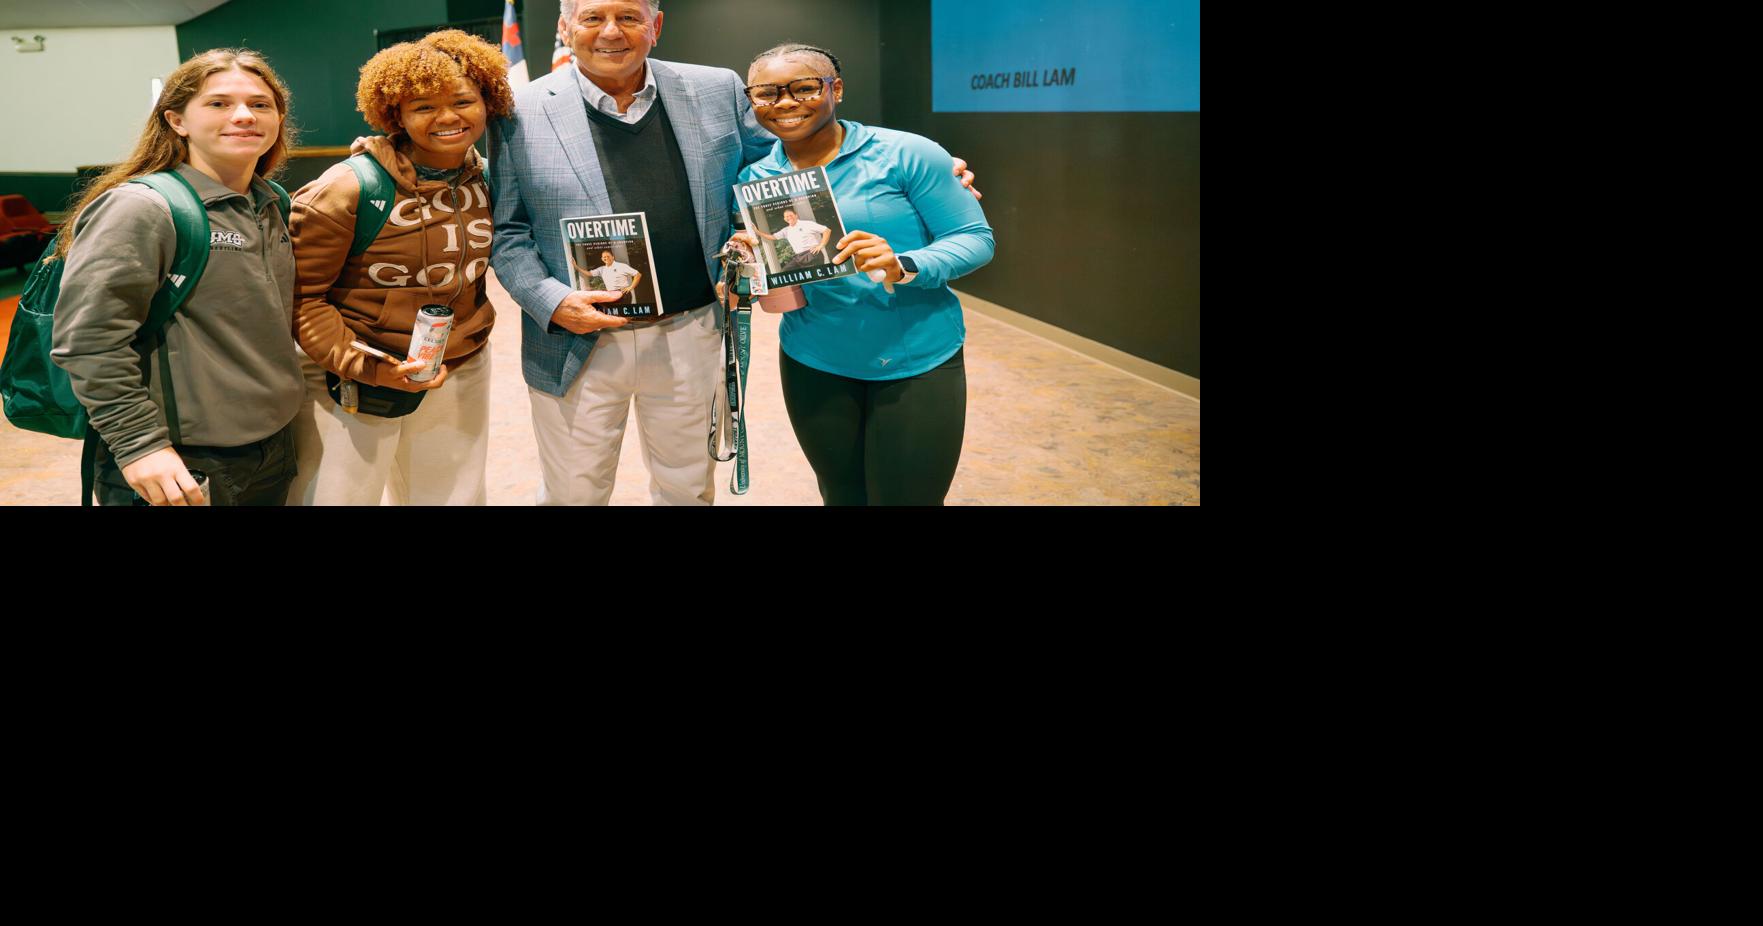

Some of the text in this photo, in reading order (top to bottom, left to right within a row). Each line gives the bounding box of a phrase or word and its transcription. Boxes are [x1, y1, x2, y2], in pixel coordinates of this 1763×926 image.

[971, 67, 1076, 90] COACH BILL LAM
[741, 170, 820, 203] OVERTIME
[441, 218, 493, 252] IS
[567, 218, 638, 239] OVERTIME
[368, 257, 489, 288] GOO
[770, 264, 847, 285] WILLIAM C. LAM
[623, 307, 631, 315] C.
[633, 305, 651, 315] LAM
